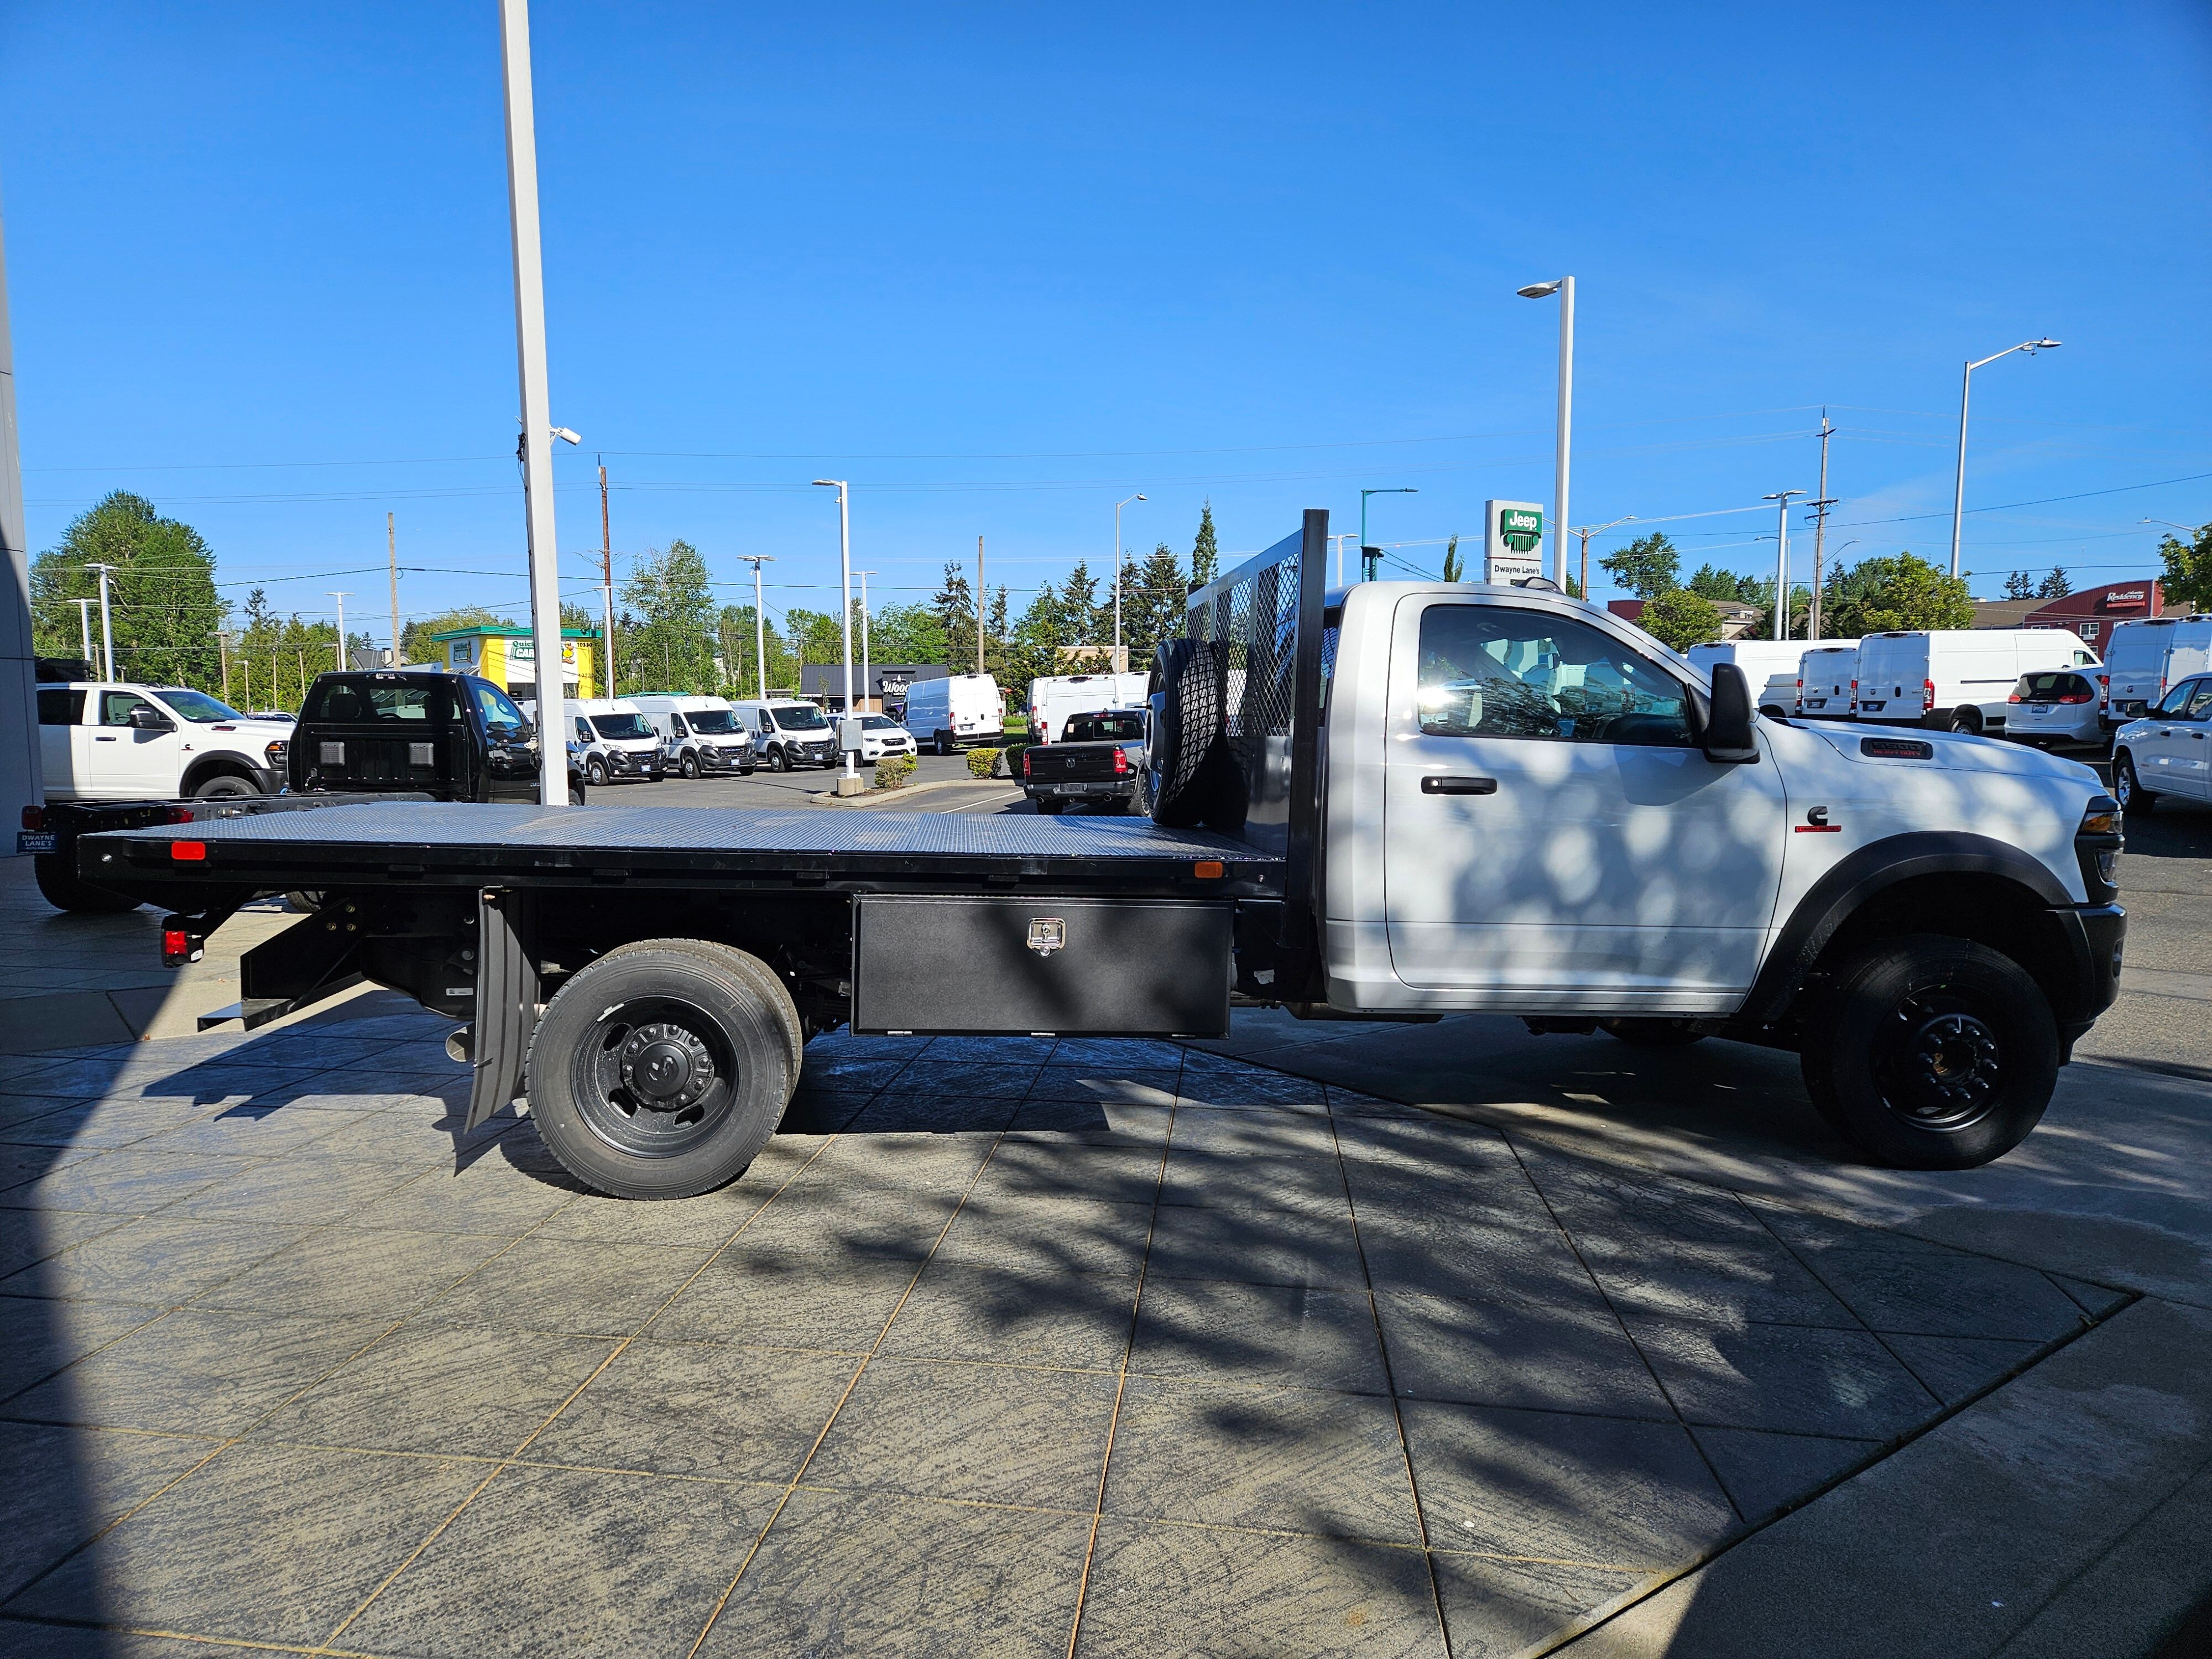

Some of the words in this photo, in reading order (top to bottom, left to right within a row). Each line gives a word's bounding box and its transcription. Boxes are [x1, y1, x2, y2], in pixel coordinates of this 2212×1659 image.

[1509, 511, 1537, 531] Jeep
[1495, 565, 1520, 574] Dwayne
[1522, 566, 1540, 575] Lane's
